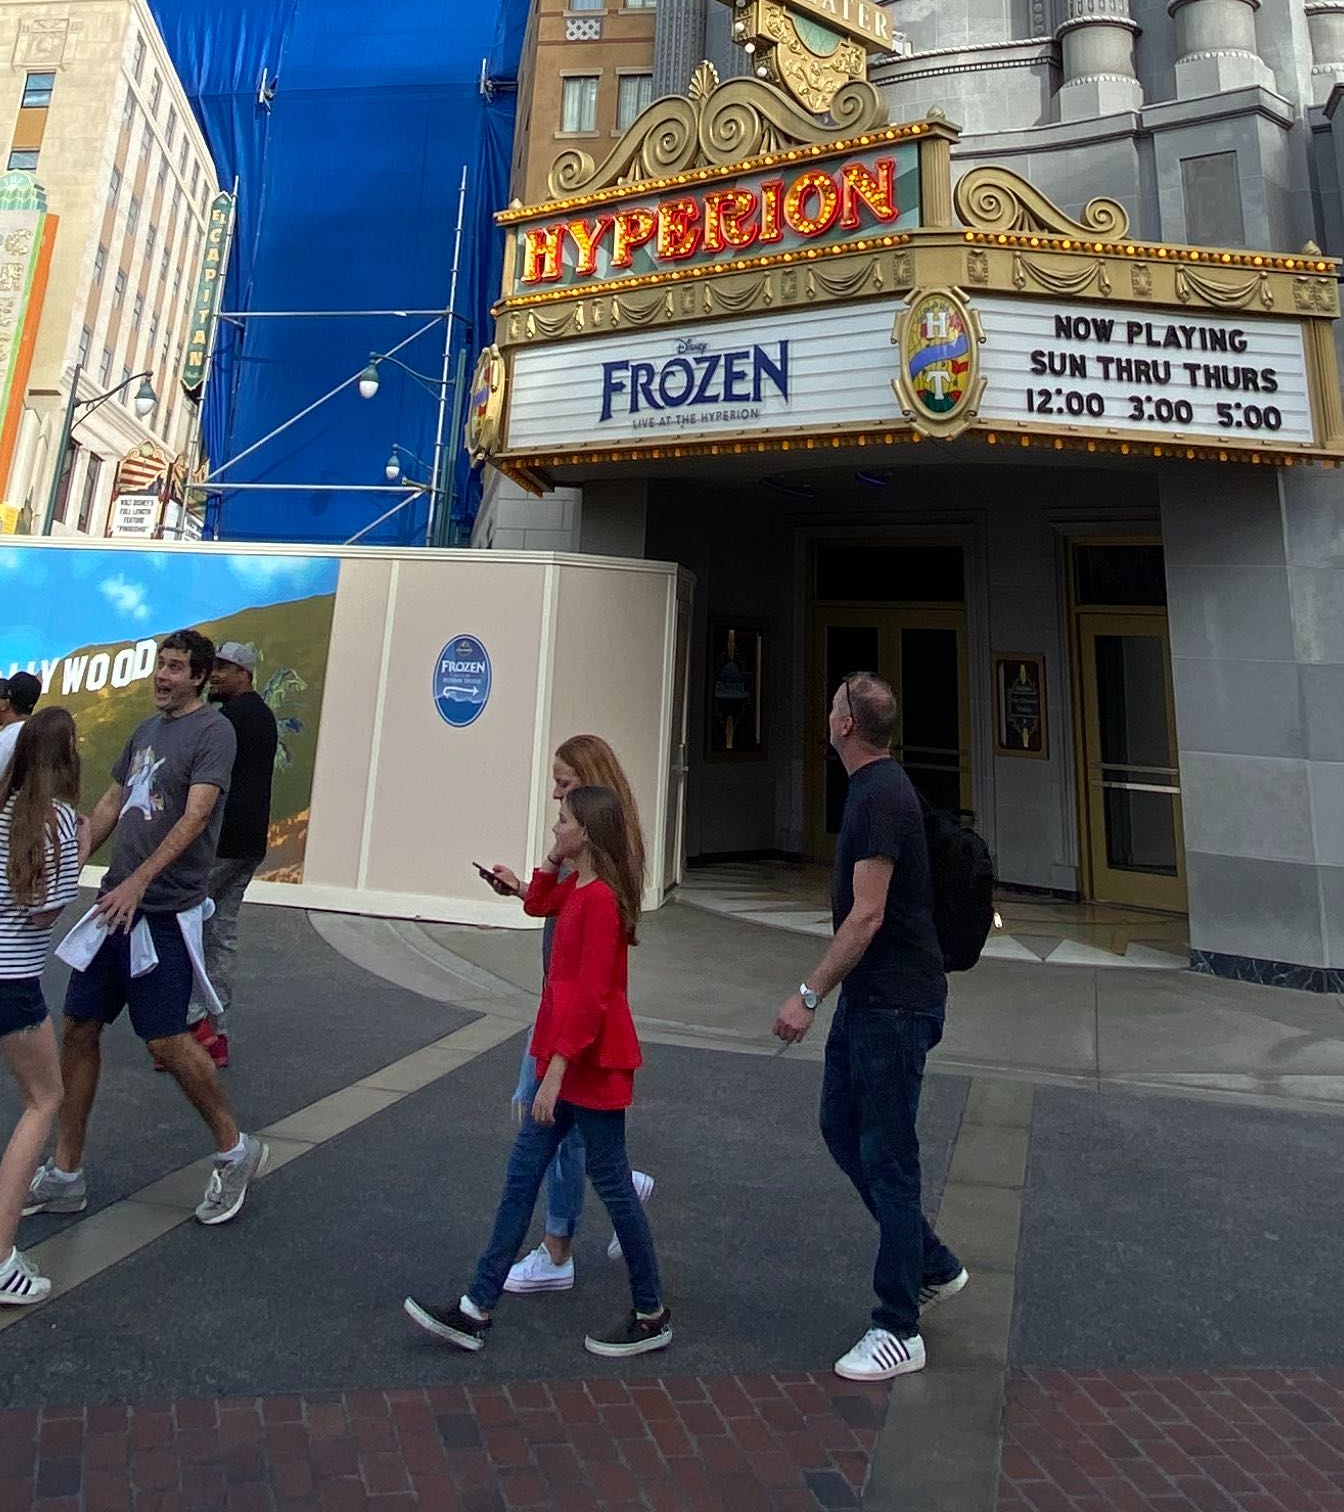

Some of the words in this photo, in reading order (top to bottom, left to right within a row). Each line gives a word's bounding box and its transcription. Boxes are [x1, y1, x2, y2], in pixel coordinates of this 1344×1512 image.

[212, 209, 226, 224] EL
[518, 155, 900, 285] HYPERION
[189, 227, 223, 366] CAPITAN
[1054, 314, 1115, 343] NOW
[1127, 320, 1248, 354] PLAYING
[599, 340, 790, 424] FROZEN
[1030, 349, 1087, 379] SUN
[1096, 355, 1171, 385] THRU
[1183, 361, 1278, 393] THURS
[632, 418, 655, 429] LIVE
[659, 416, 673, 426] AT
[676, 414, 697, 425] THE
[700, 408, 760, 423] HYPERION
[1026, 388, 1105, 418] 12:00
[1127, 395, 1194, 424] 3:00
[1216, 402, 1282, 431] 5:00
[441, 660, 486, 673] FROZEN
